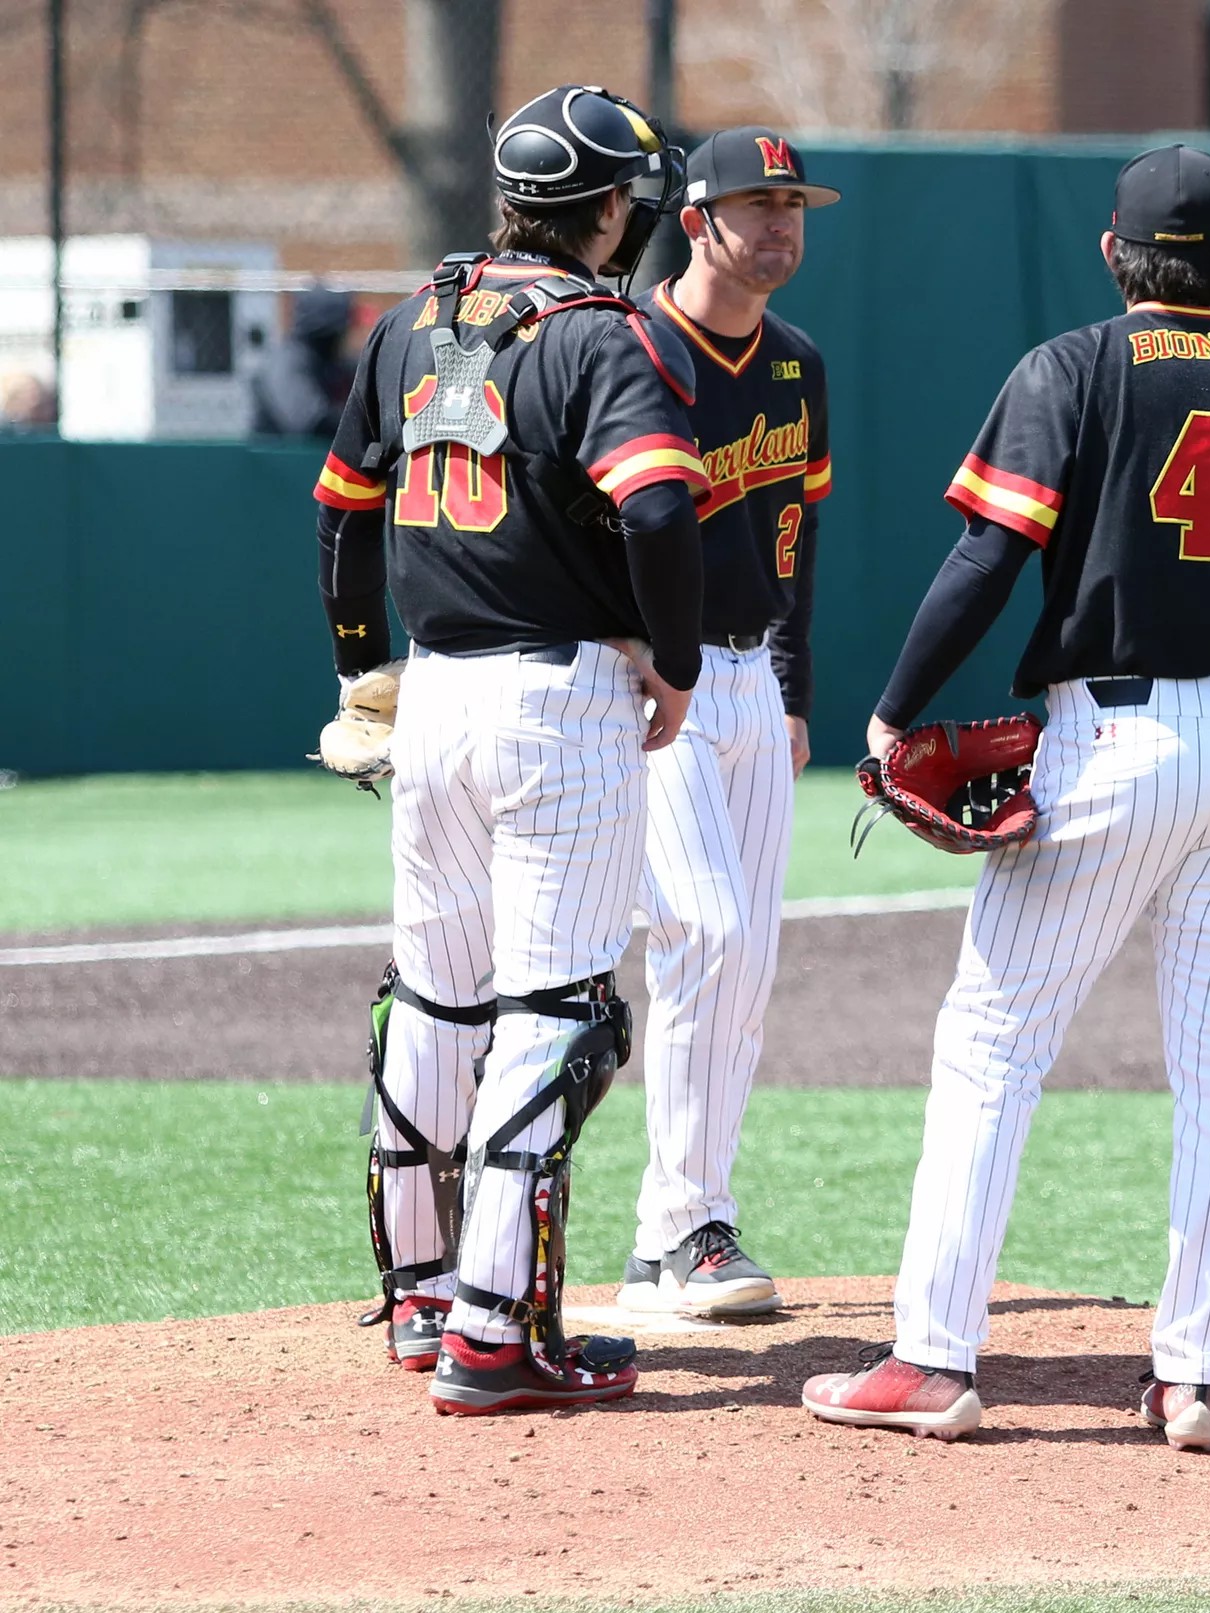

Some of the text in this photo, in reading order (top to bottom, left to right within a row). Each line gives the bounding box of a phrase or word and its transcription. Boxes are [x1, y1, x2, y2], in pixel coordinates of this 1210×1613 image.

[755, 136, 798, 178] M
[394, 374, 508, 533] 10
[695, 398, 809, 492] aryland
[776, 503, 803, 579] 2
